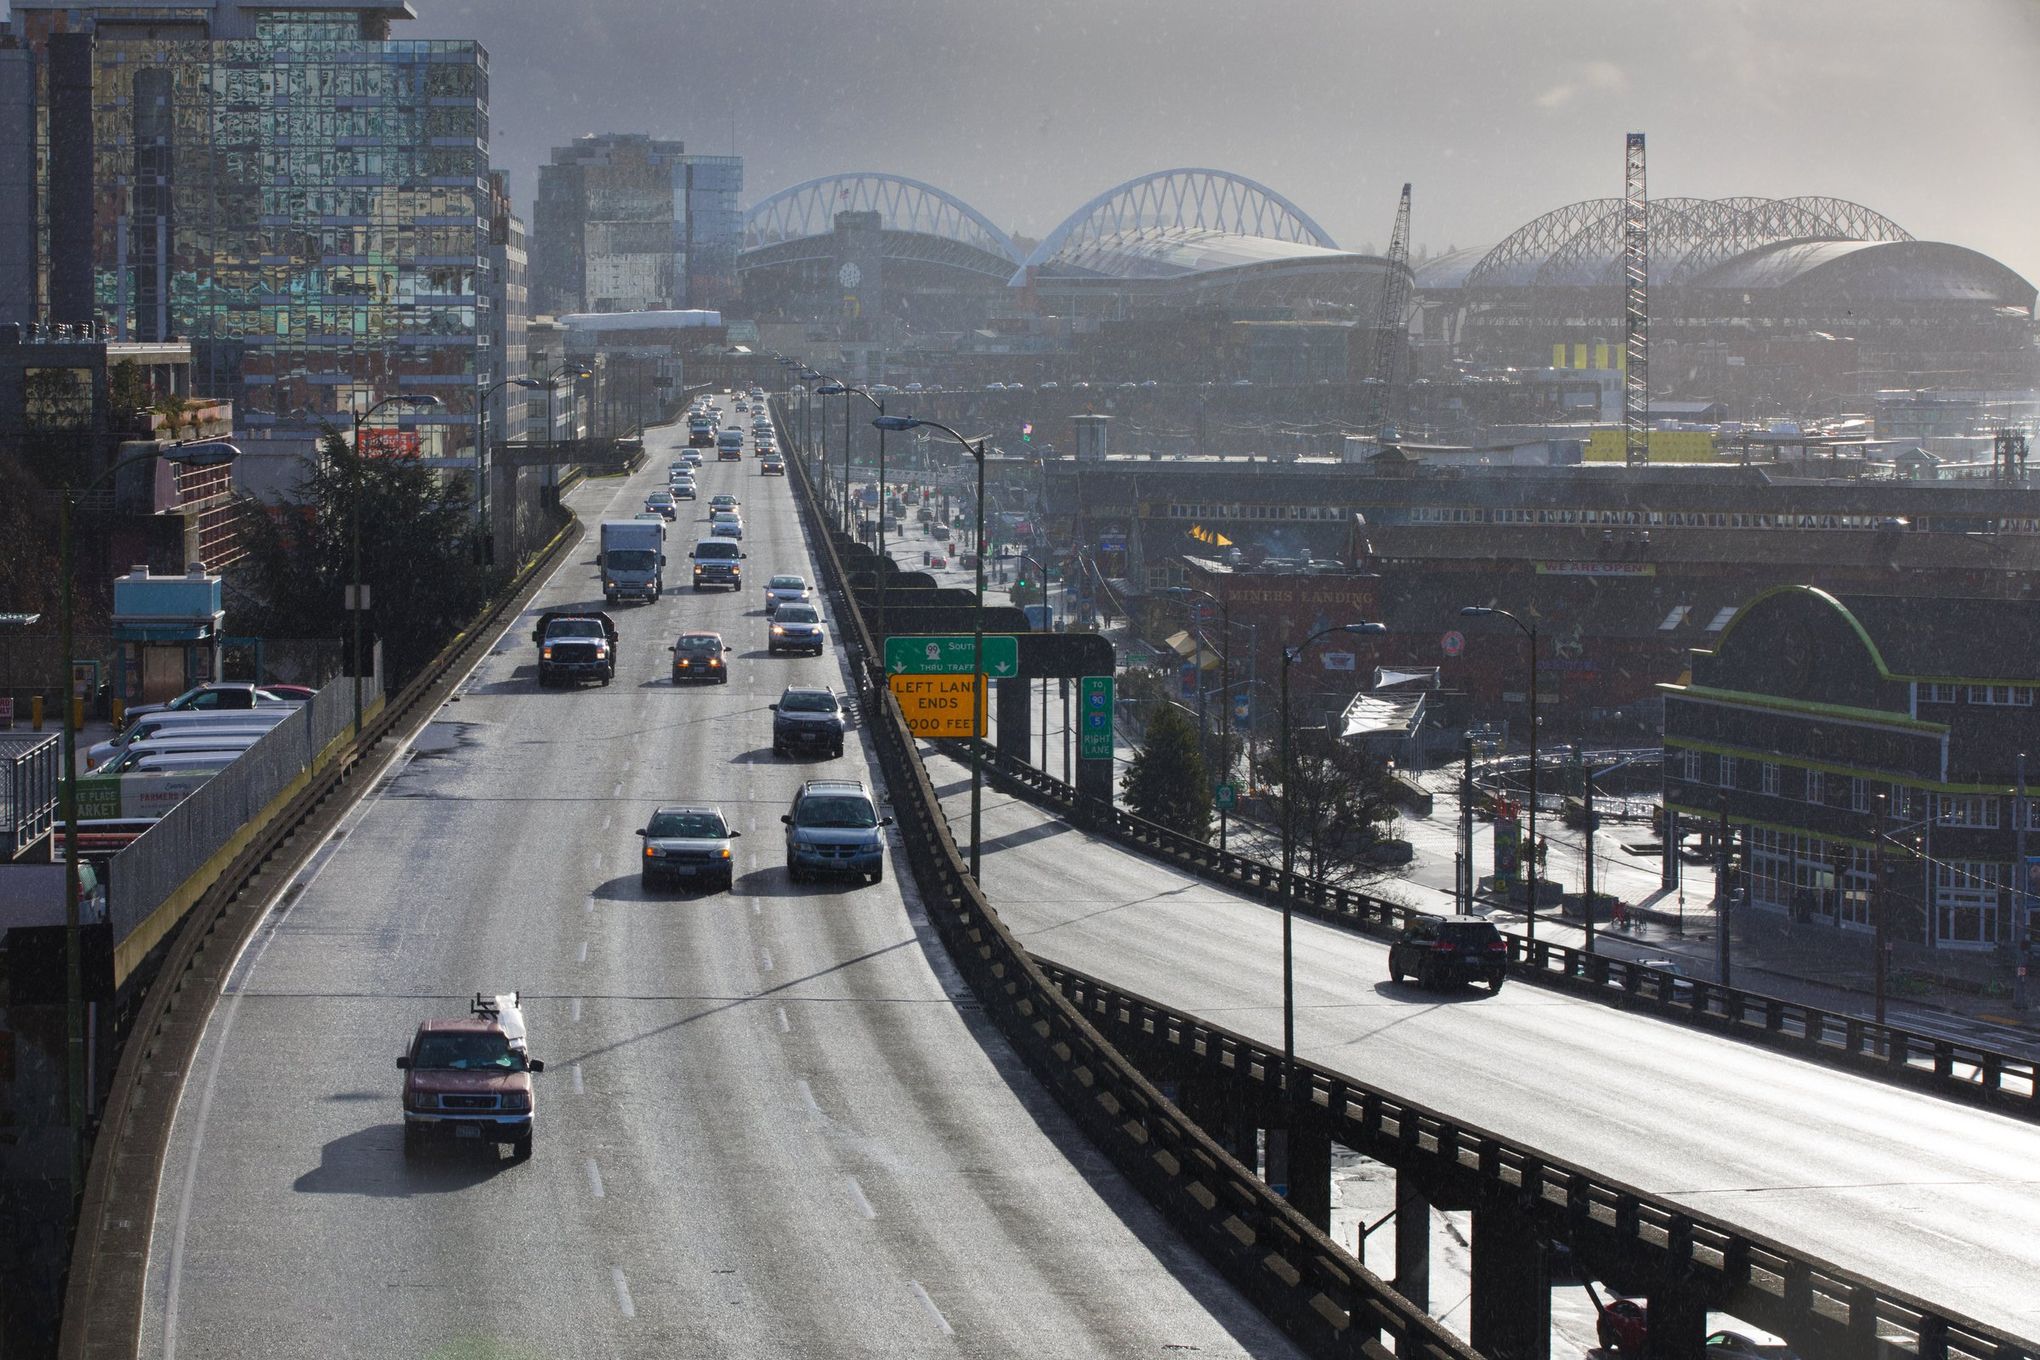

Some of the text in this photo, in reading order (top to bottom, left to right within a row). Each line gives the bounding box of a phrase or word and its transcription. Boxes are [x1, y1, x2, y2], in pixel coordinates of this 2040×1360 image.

[1301, 591, 1373, 604] LANDING
[927, 645, 938, 654] 99
[896, 682, 933, 693] LEFT
[919, 698, 958, 709] ENDS
[1092, 695, 1104, 705] 90
[908, 719, 975, 730] 000 FEE
[1095, 717, 1102, 726] 5
[1084, 735, 1110, 743] RIGHT
[1085, 745, 1110, 754] LANE
[77, 802, 117, 817] ARKET
